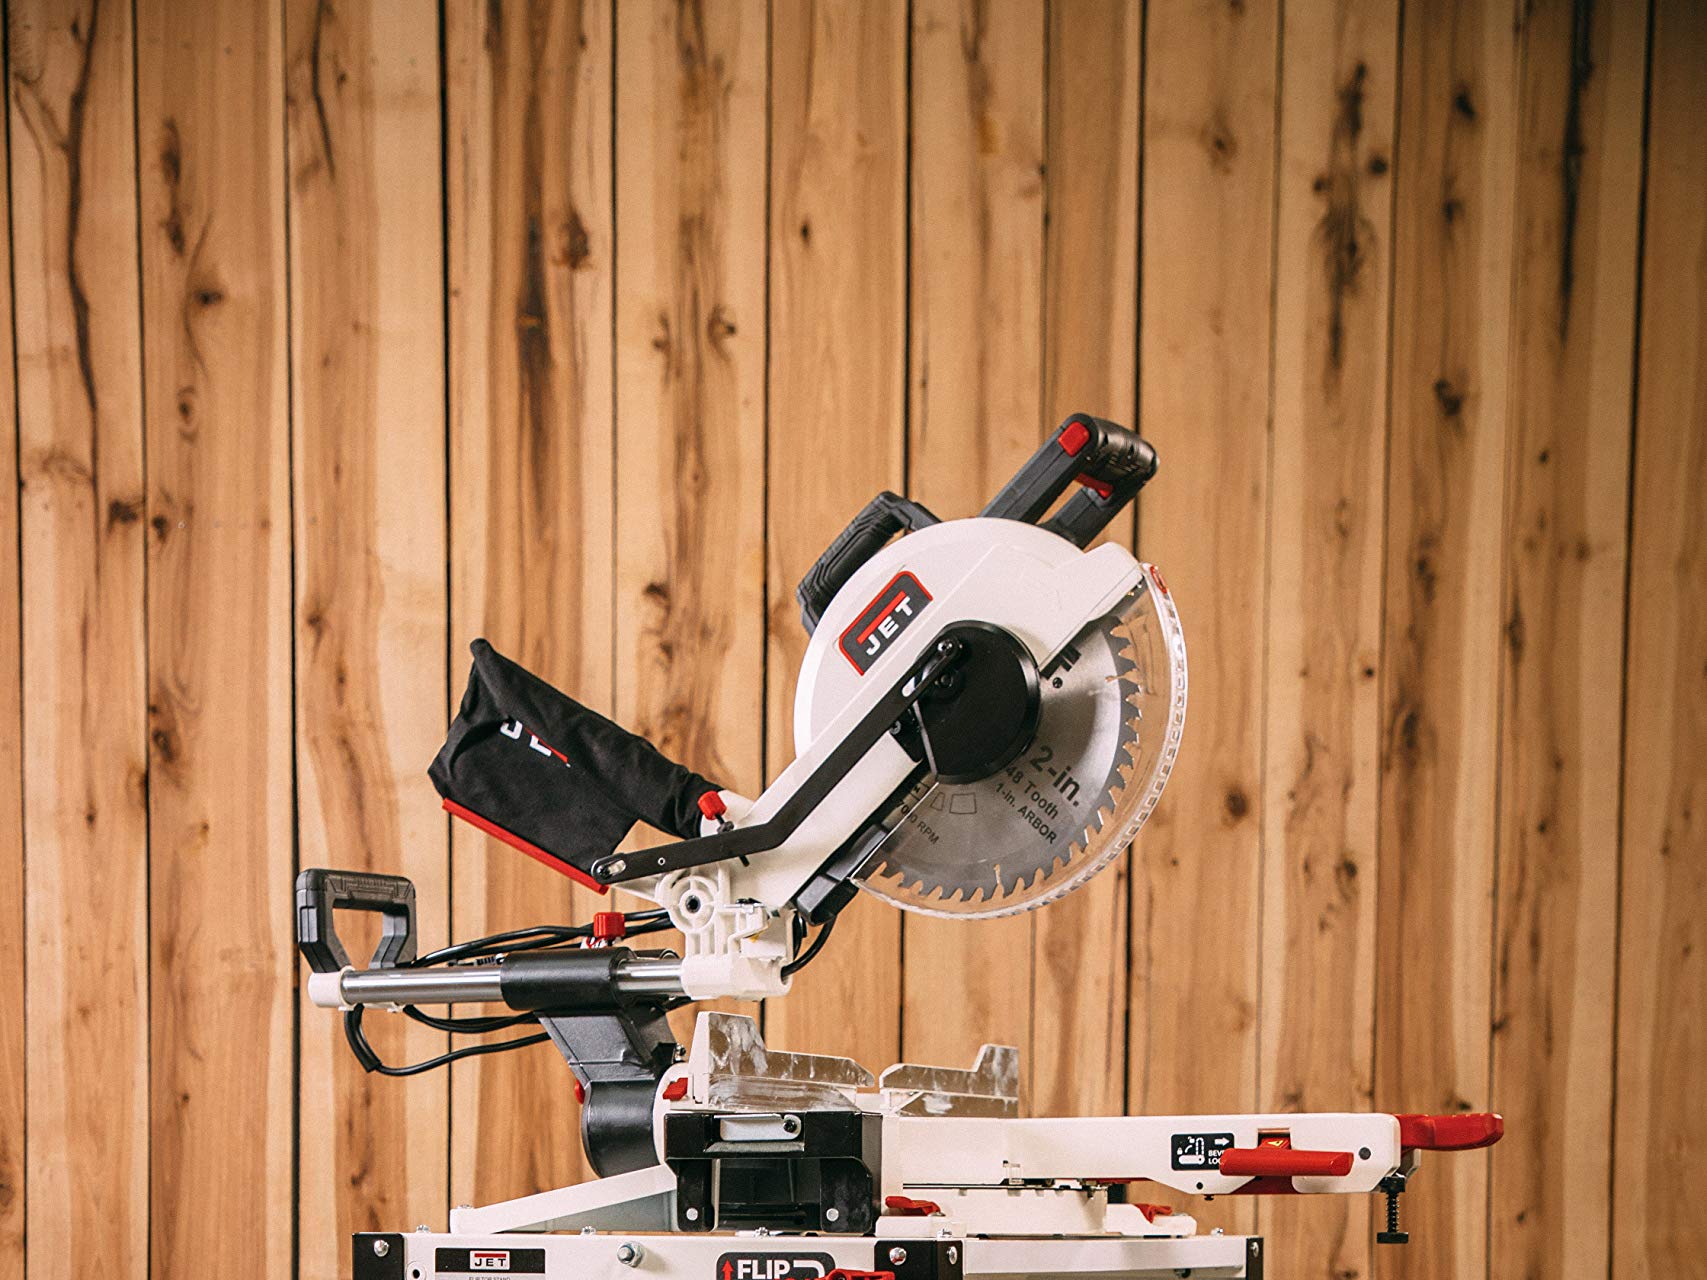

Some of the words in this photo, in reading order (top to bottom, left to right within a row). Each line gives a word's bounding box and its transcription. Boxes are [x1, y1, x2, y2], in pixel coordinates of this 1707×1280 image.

[866, 596, 913, 655] JET
[1024, 781, 1059, 820] Tooth
[996, 783, 1015, 807] 1-in.
[1017, 805, 1057, 844] ARBOR
[917, 821, 940, 845] RPM
[1208, 1149, 1225, 1157] BEV
[474, 1258, 507, 1267] JET
[737, 1259, 791, 1280] FLIP
